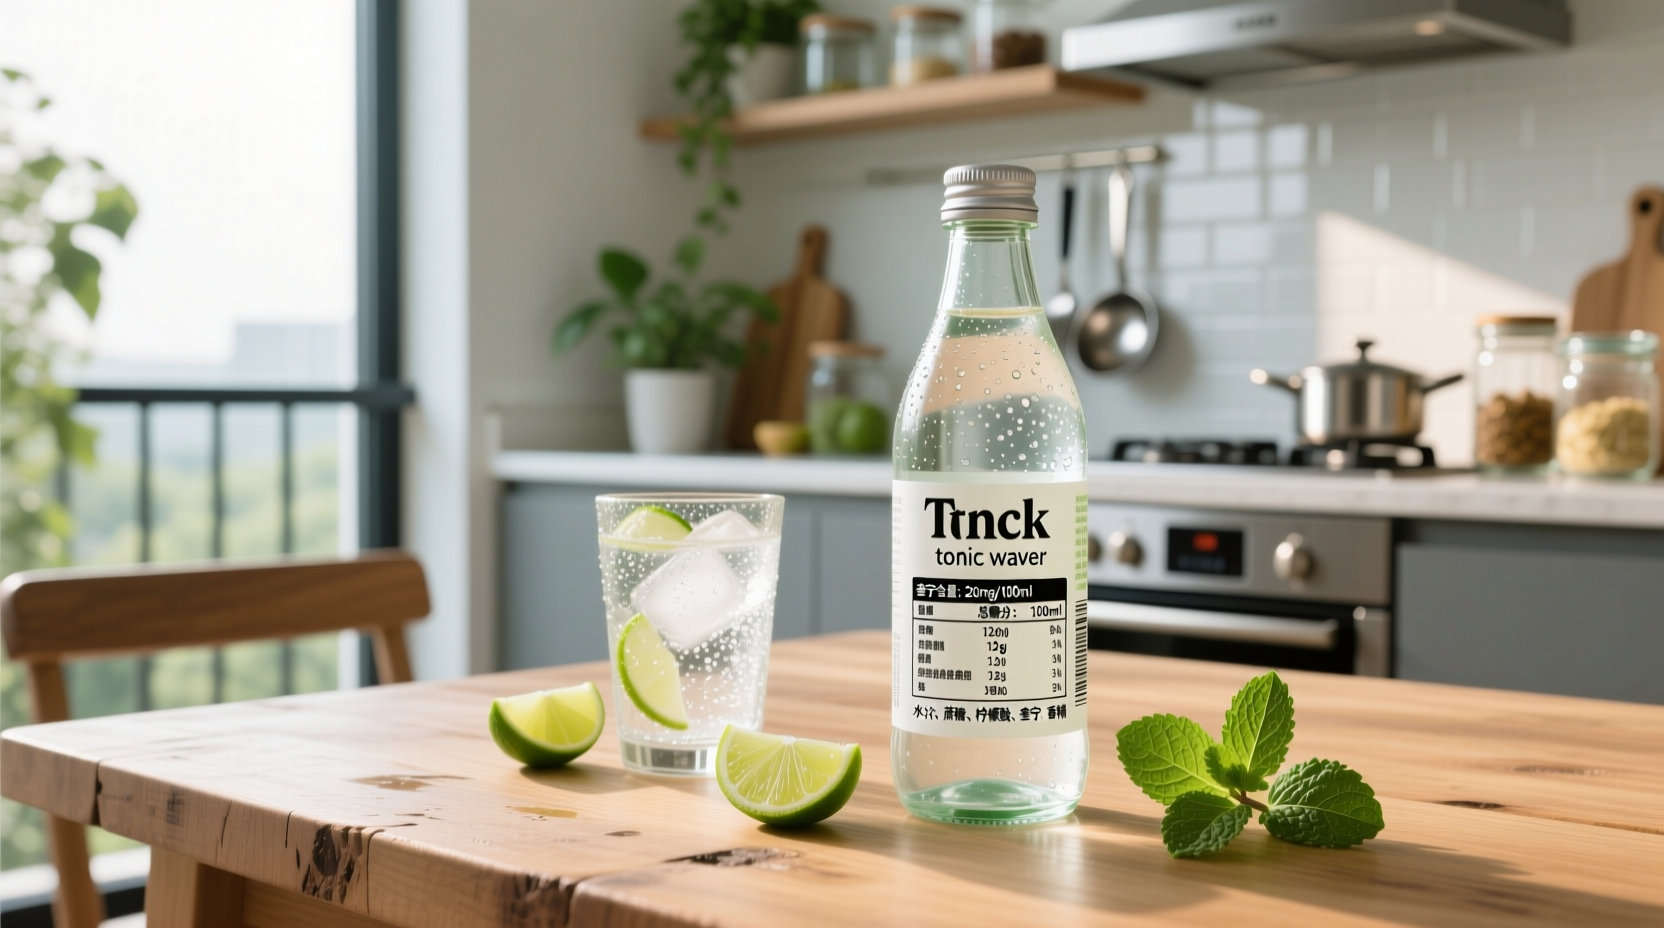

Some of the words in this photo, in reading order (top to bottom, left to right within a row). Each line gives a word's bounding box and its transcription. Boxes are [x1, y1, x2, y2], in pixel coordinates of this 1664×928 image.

[935, 546, 985, 567] tonic
[989, 551, 1047, 567] waver
[1030, 604, 1062, 618] 100ml
